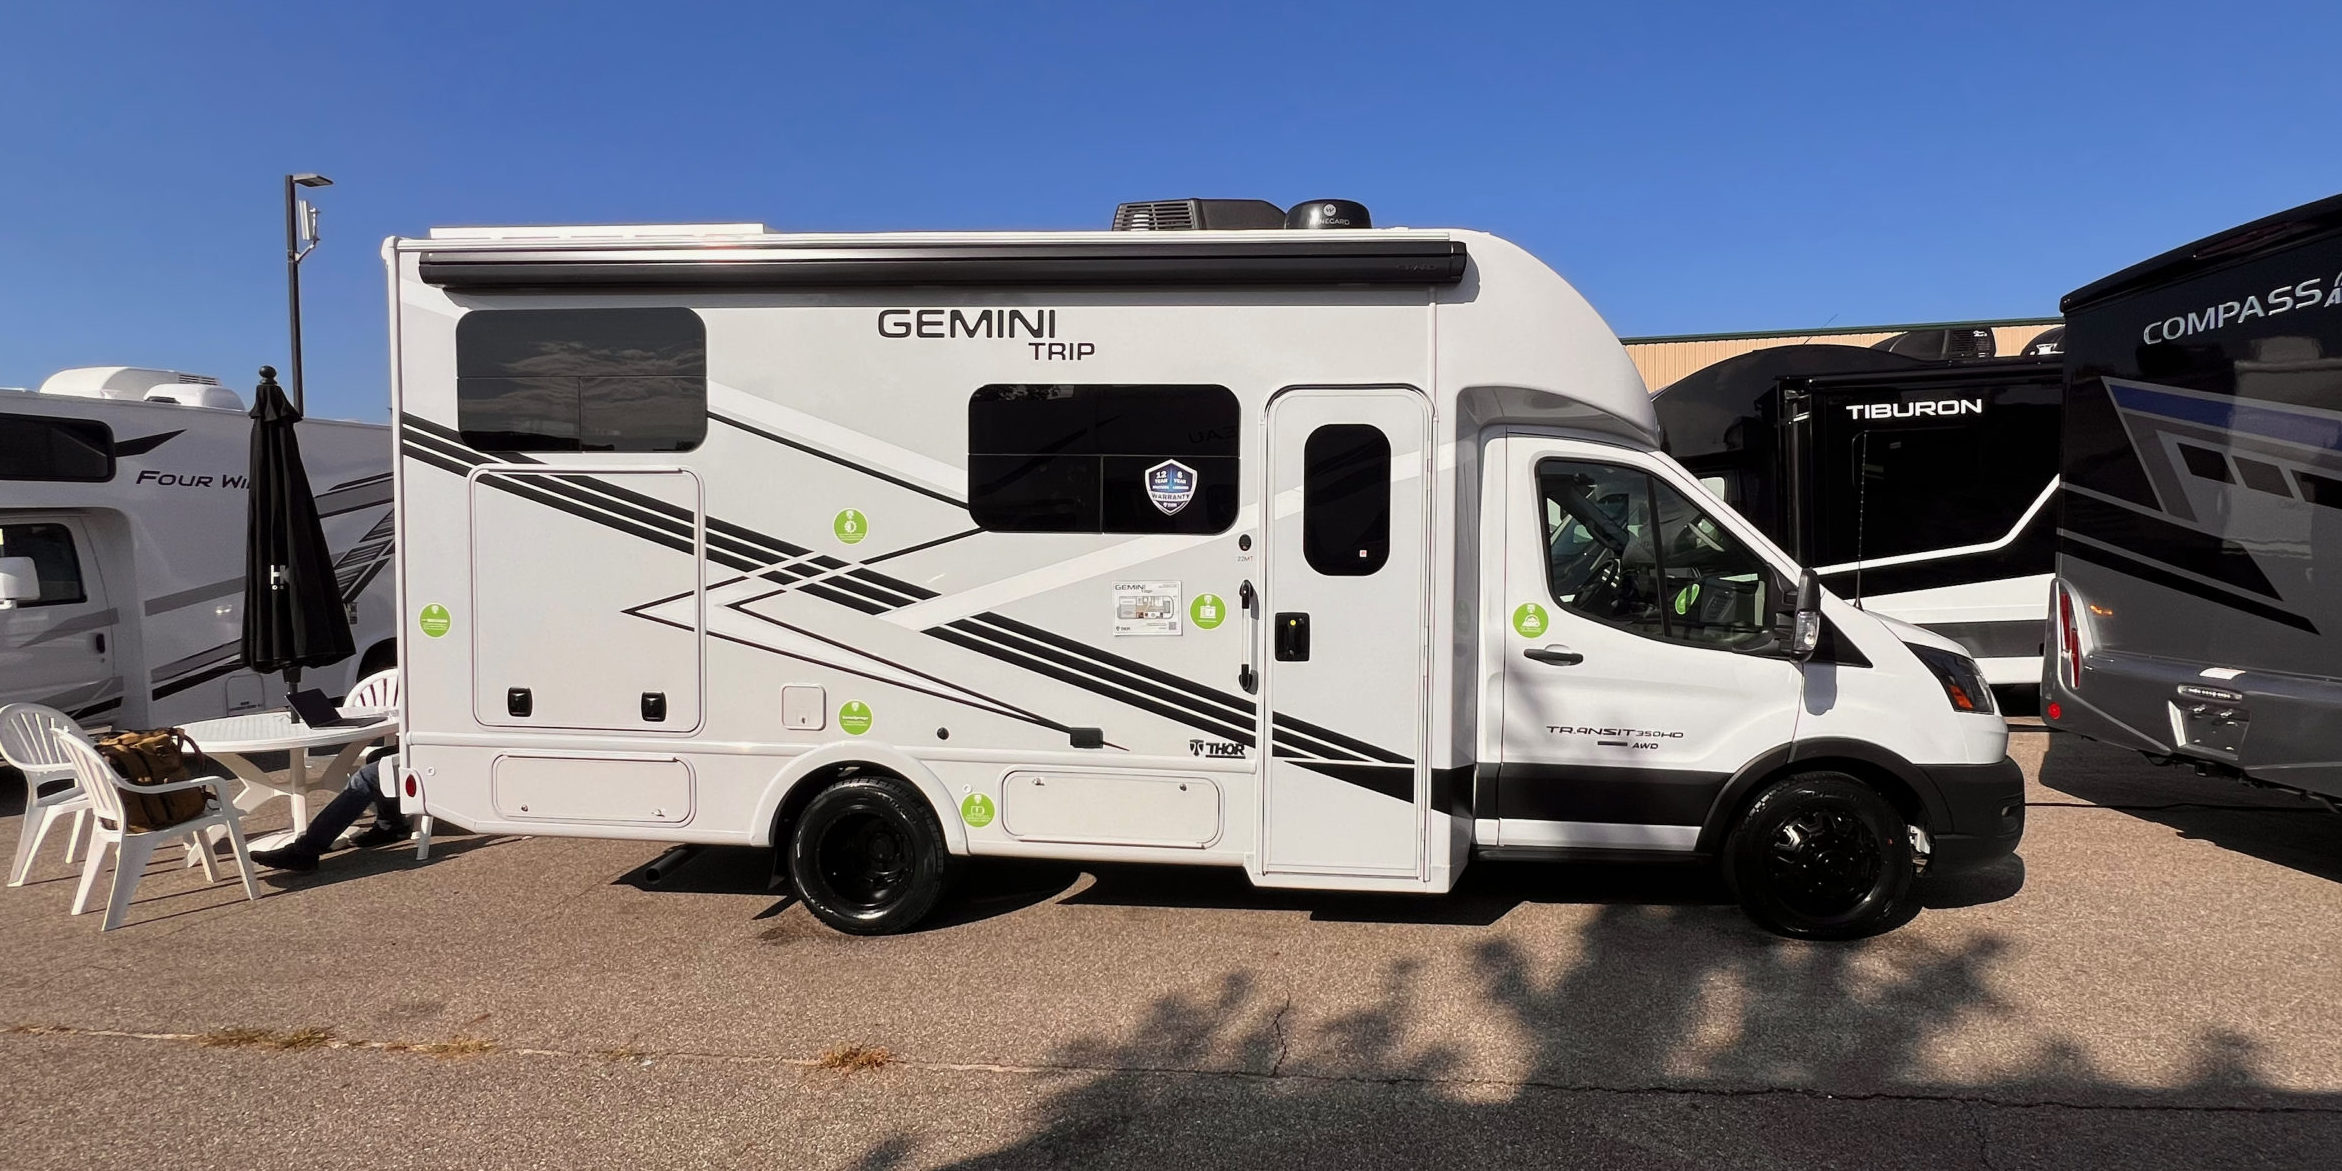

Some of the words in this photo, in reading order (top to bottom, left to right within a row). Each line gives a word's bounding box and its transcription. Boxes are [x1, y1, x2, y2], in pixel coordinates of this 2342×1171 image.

[2143, 278, 2323, 345] COMPASS
[878, 309, 1055, 338] GEMINI
[1028, 342, 1095, 361] TRIP
[1846, 399, 1982, 420] TIBURON
[1156, 470, 1167, 479] 12
[1151, 492, 1190, 501] WARRANTY
[1546, 726, 1636, 737] TRANSIT
[1205, 742, 1246, 756] THOR
[1631, 742, 1659, 750] AWD
